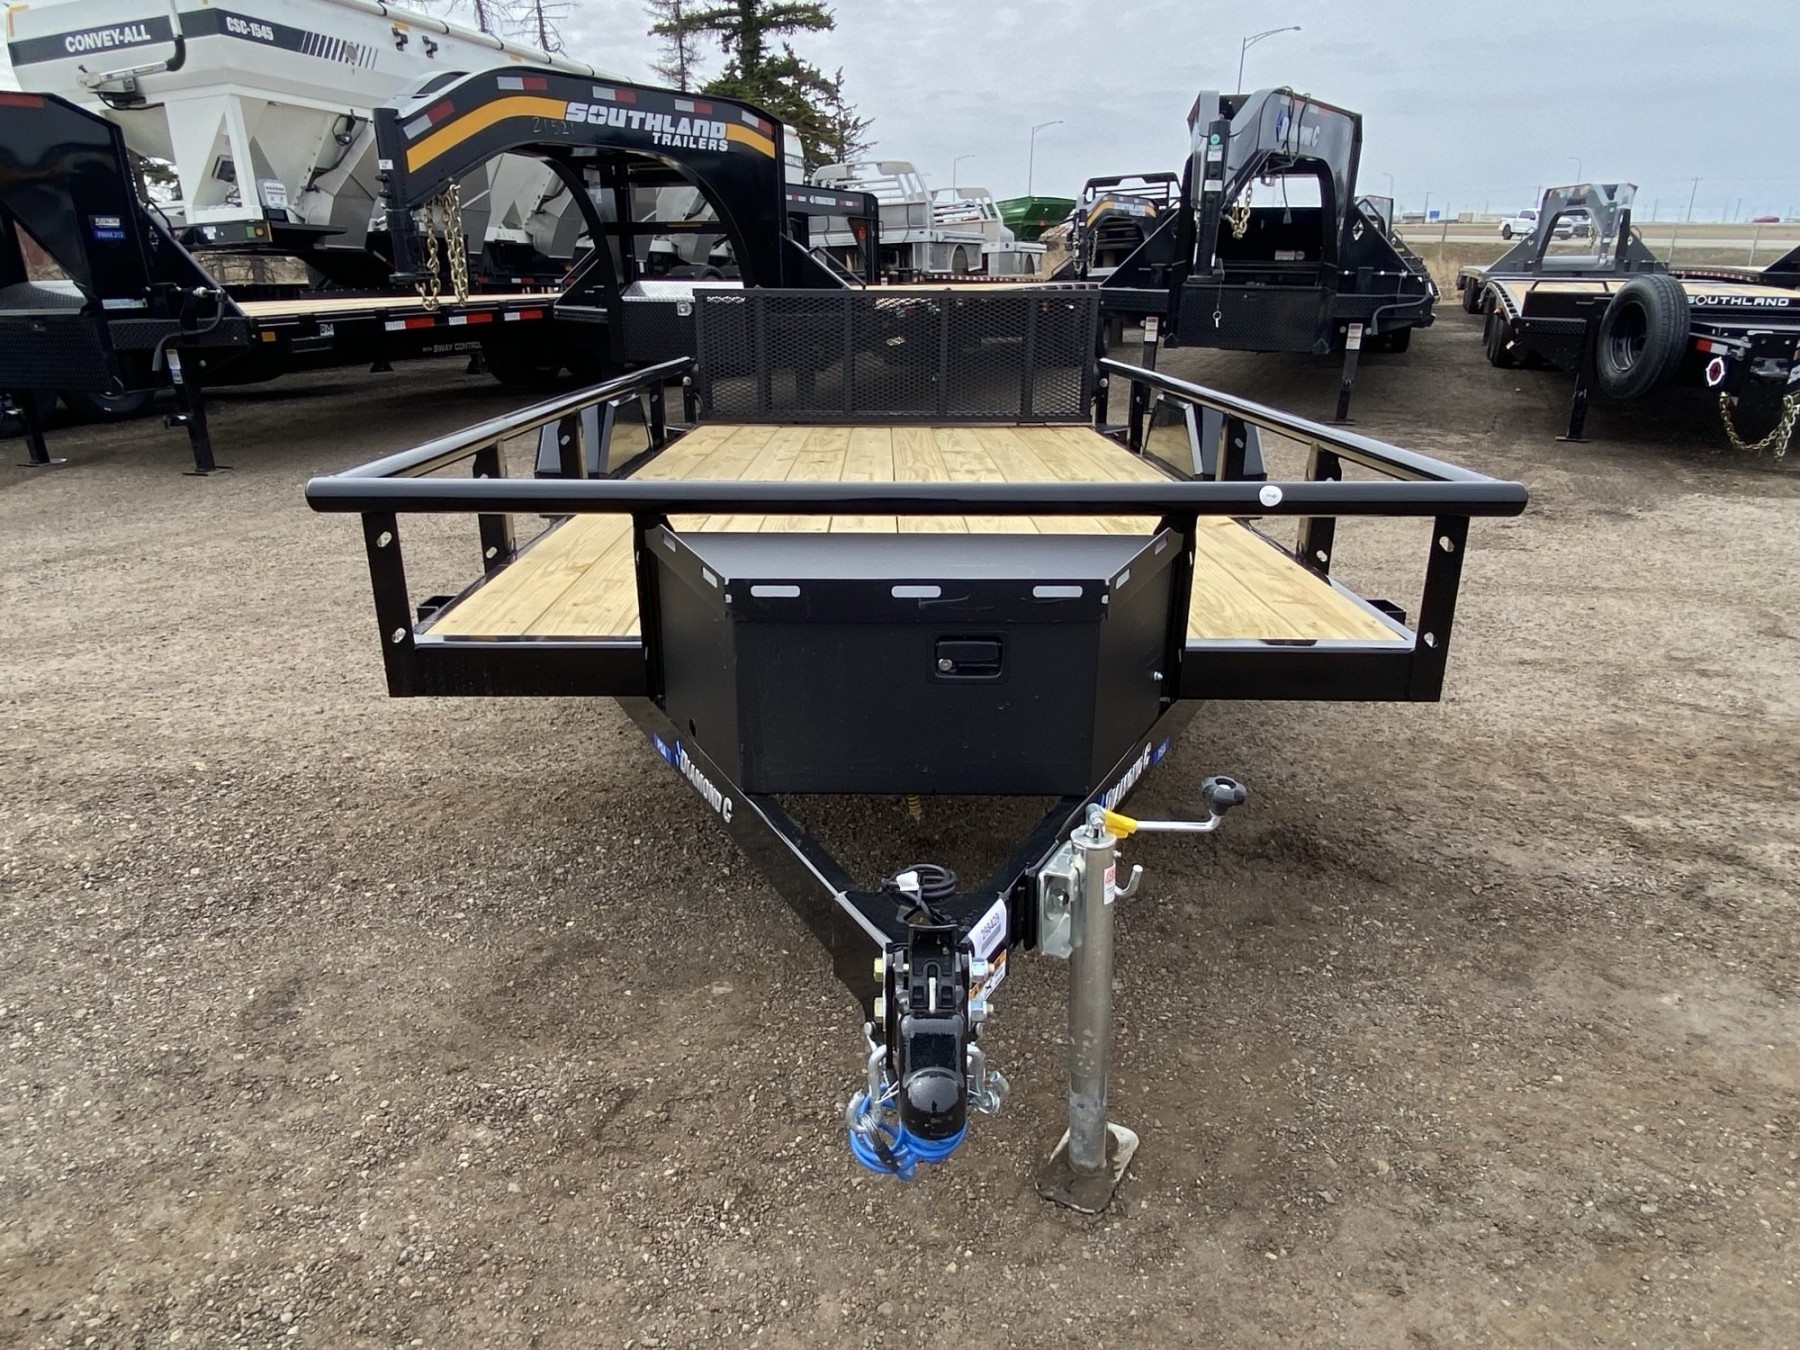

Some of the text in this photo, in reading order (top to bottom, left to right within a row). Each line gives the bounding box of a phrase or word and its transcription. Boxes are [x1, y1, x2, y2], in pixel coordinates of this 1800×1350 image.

[65, 24, 151, 53] CONVEY-ALL
[226, 16, 274, 41] CSC-1545
[565, 101, 727, 139] SOUTHLAND
[652, 132, 729, 152] TRAILERS
[1687, 294, 1790, 307] SOUTHLAND
[433, 343, 453, 353] SWAY
[454, 341, 482, 351] CONTROL
[680, 748, 733, 824] DIAMOND C
